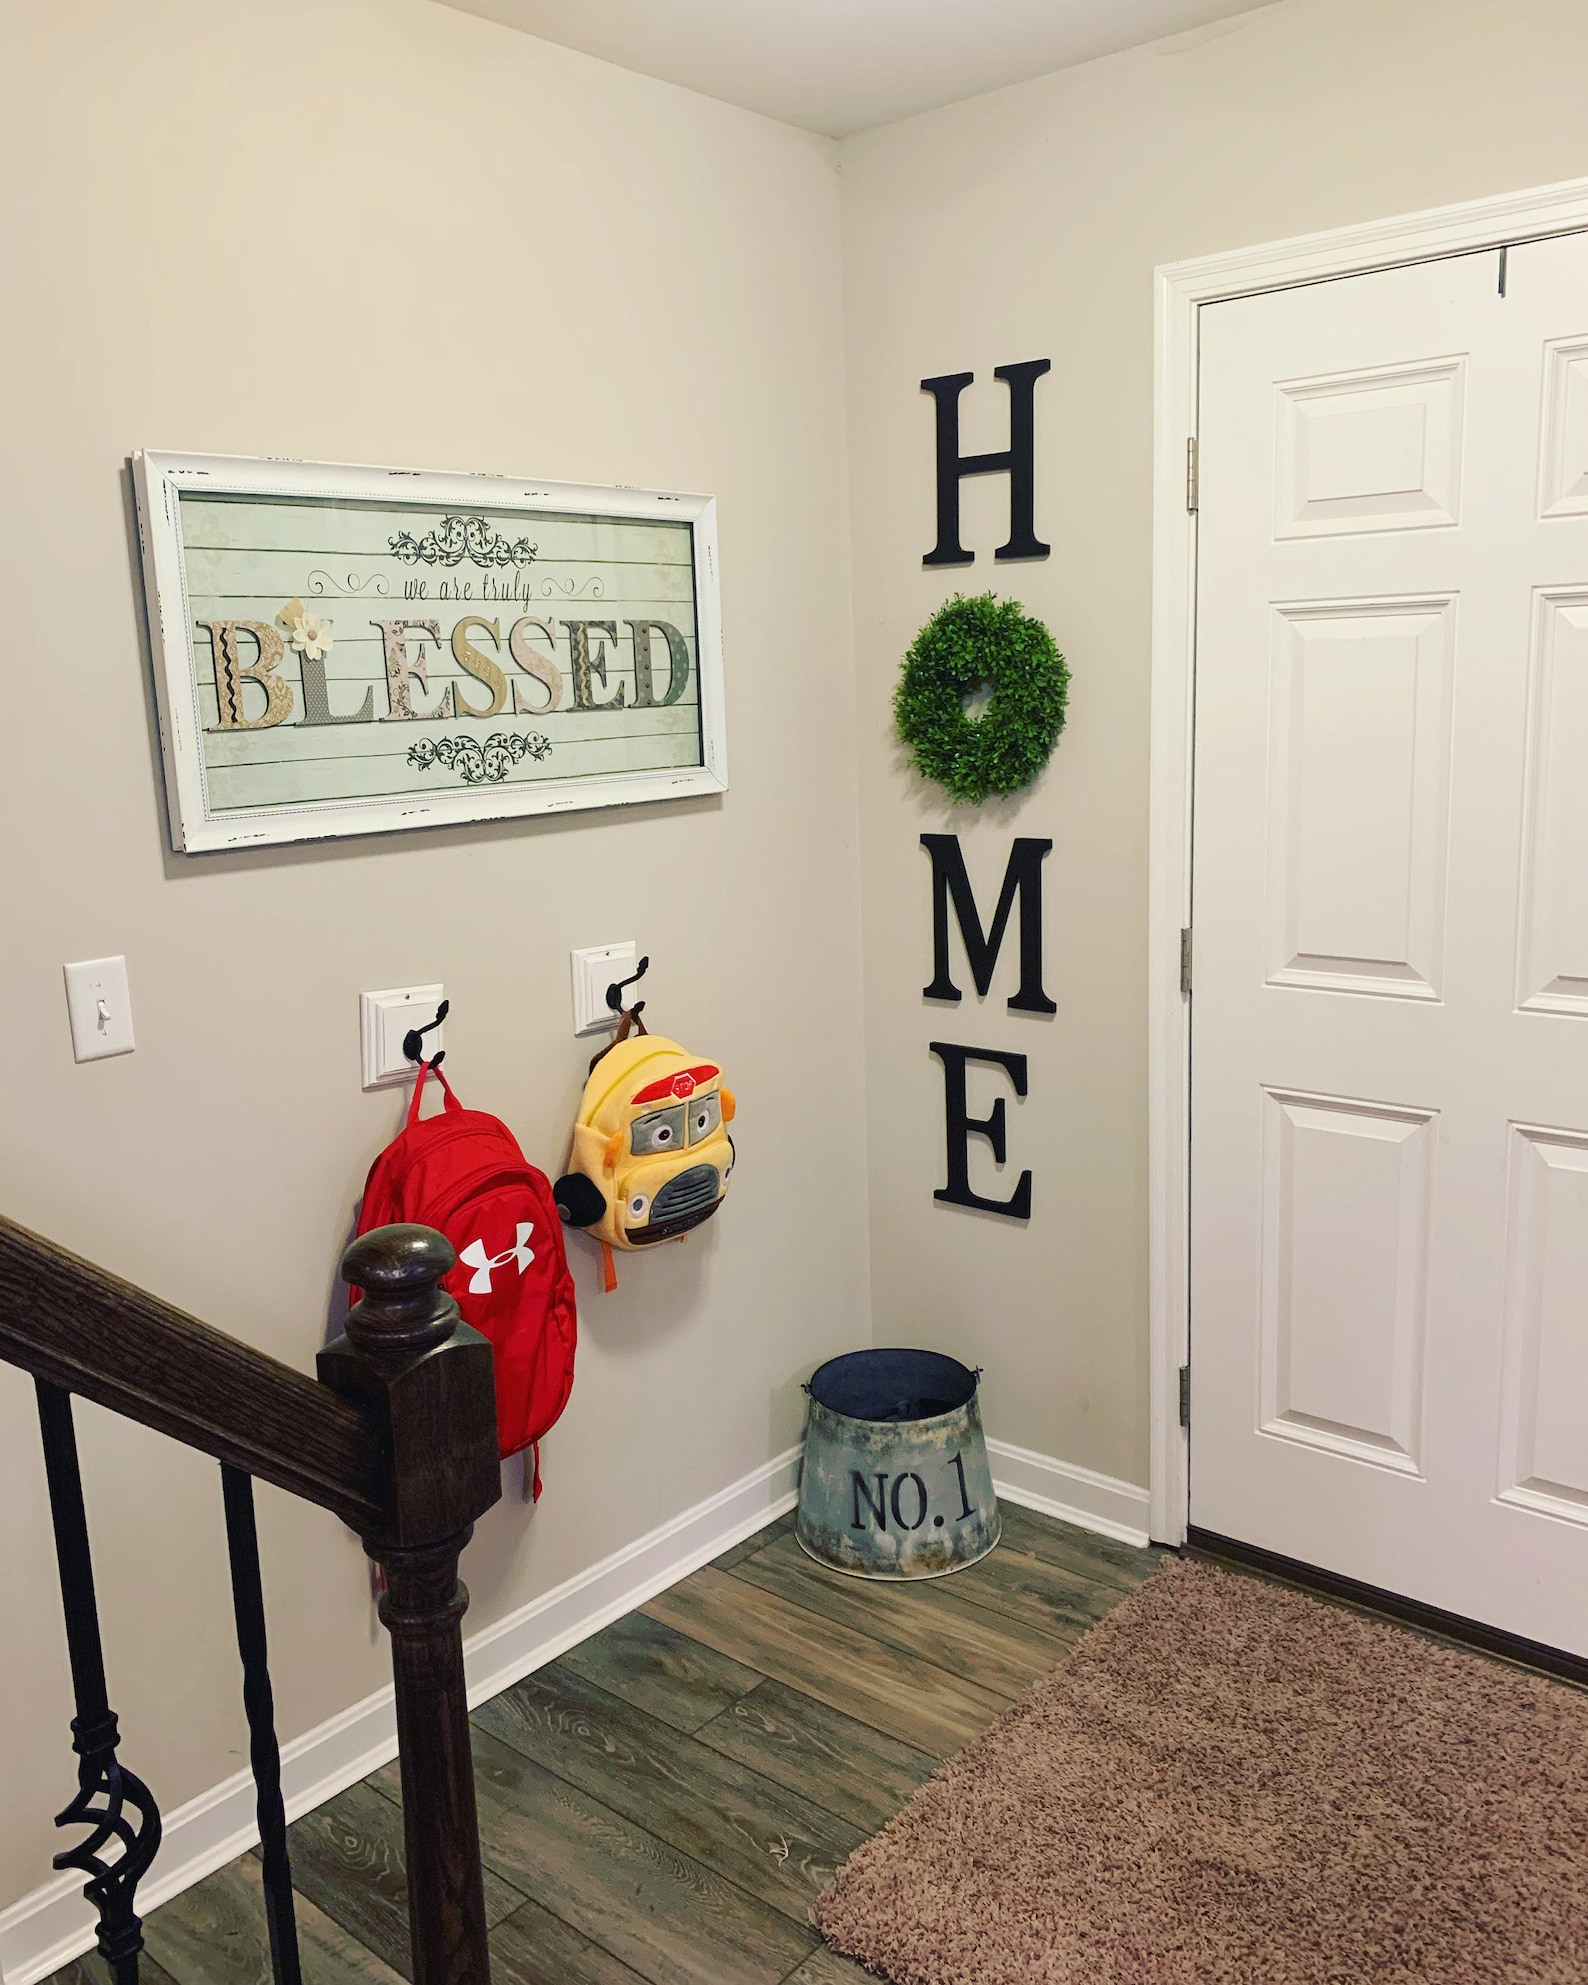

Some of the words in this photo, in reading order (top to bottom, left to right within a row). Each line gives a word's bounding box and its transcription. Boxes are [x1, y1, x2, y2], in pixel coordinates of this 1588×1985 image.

[404, 578, 429, 600] we
[439, 576, 474, 600] are
[482, 570, 532, 613] truly
[196, 616, 691, 731] BLESSED
